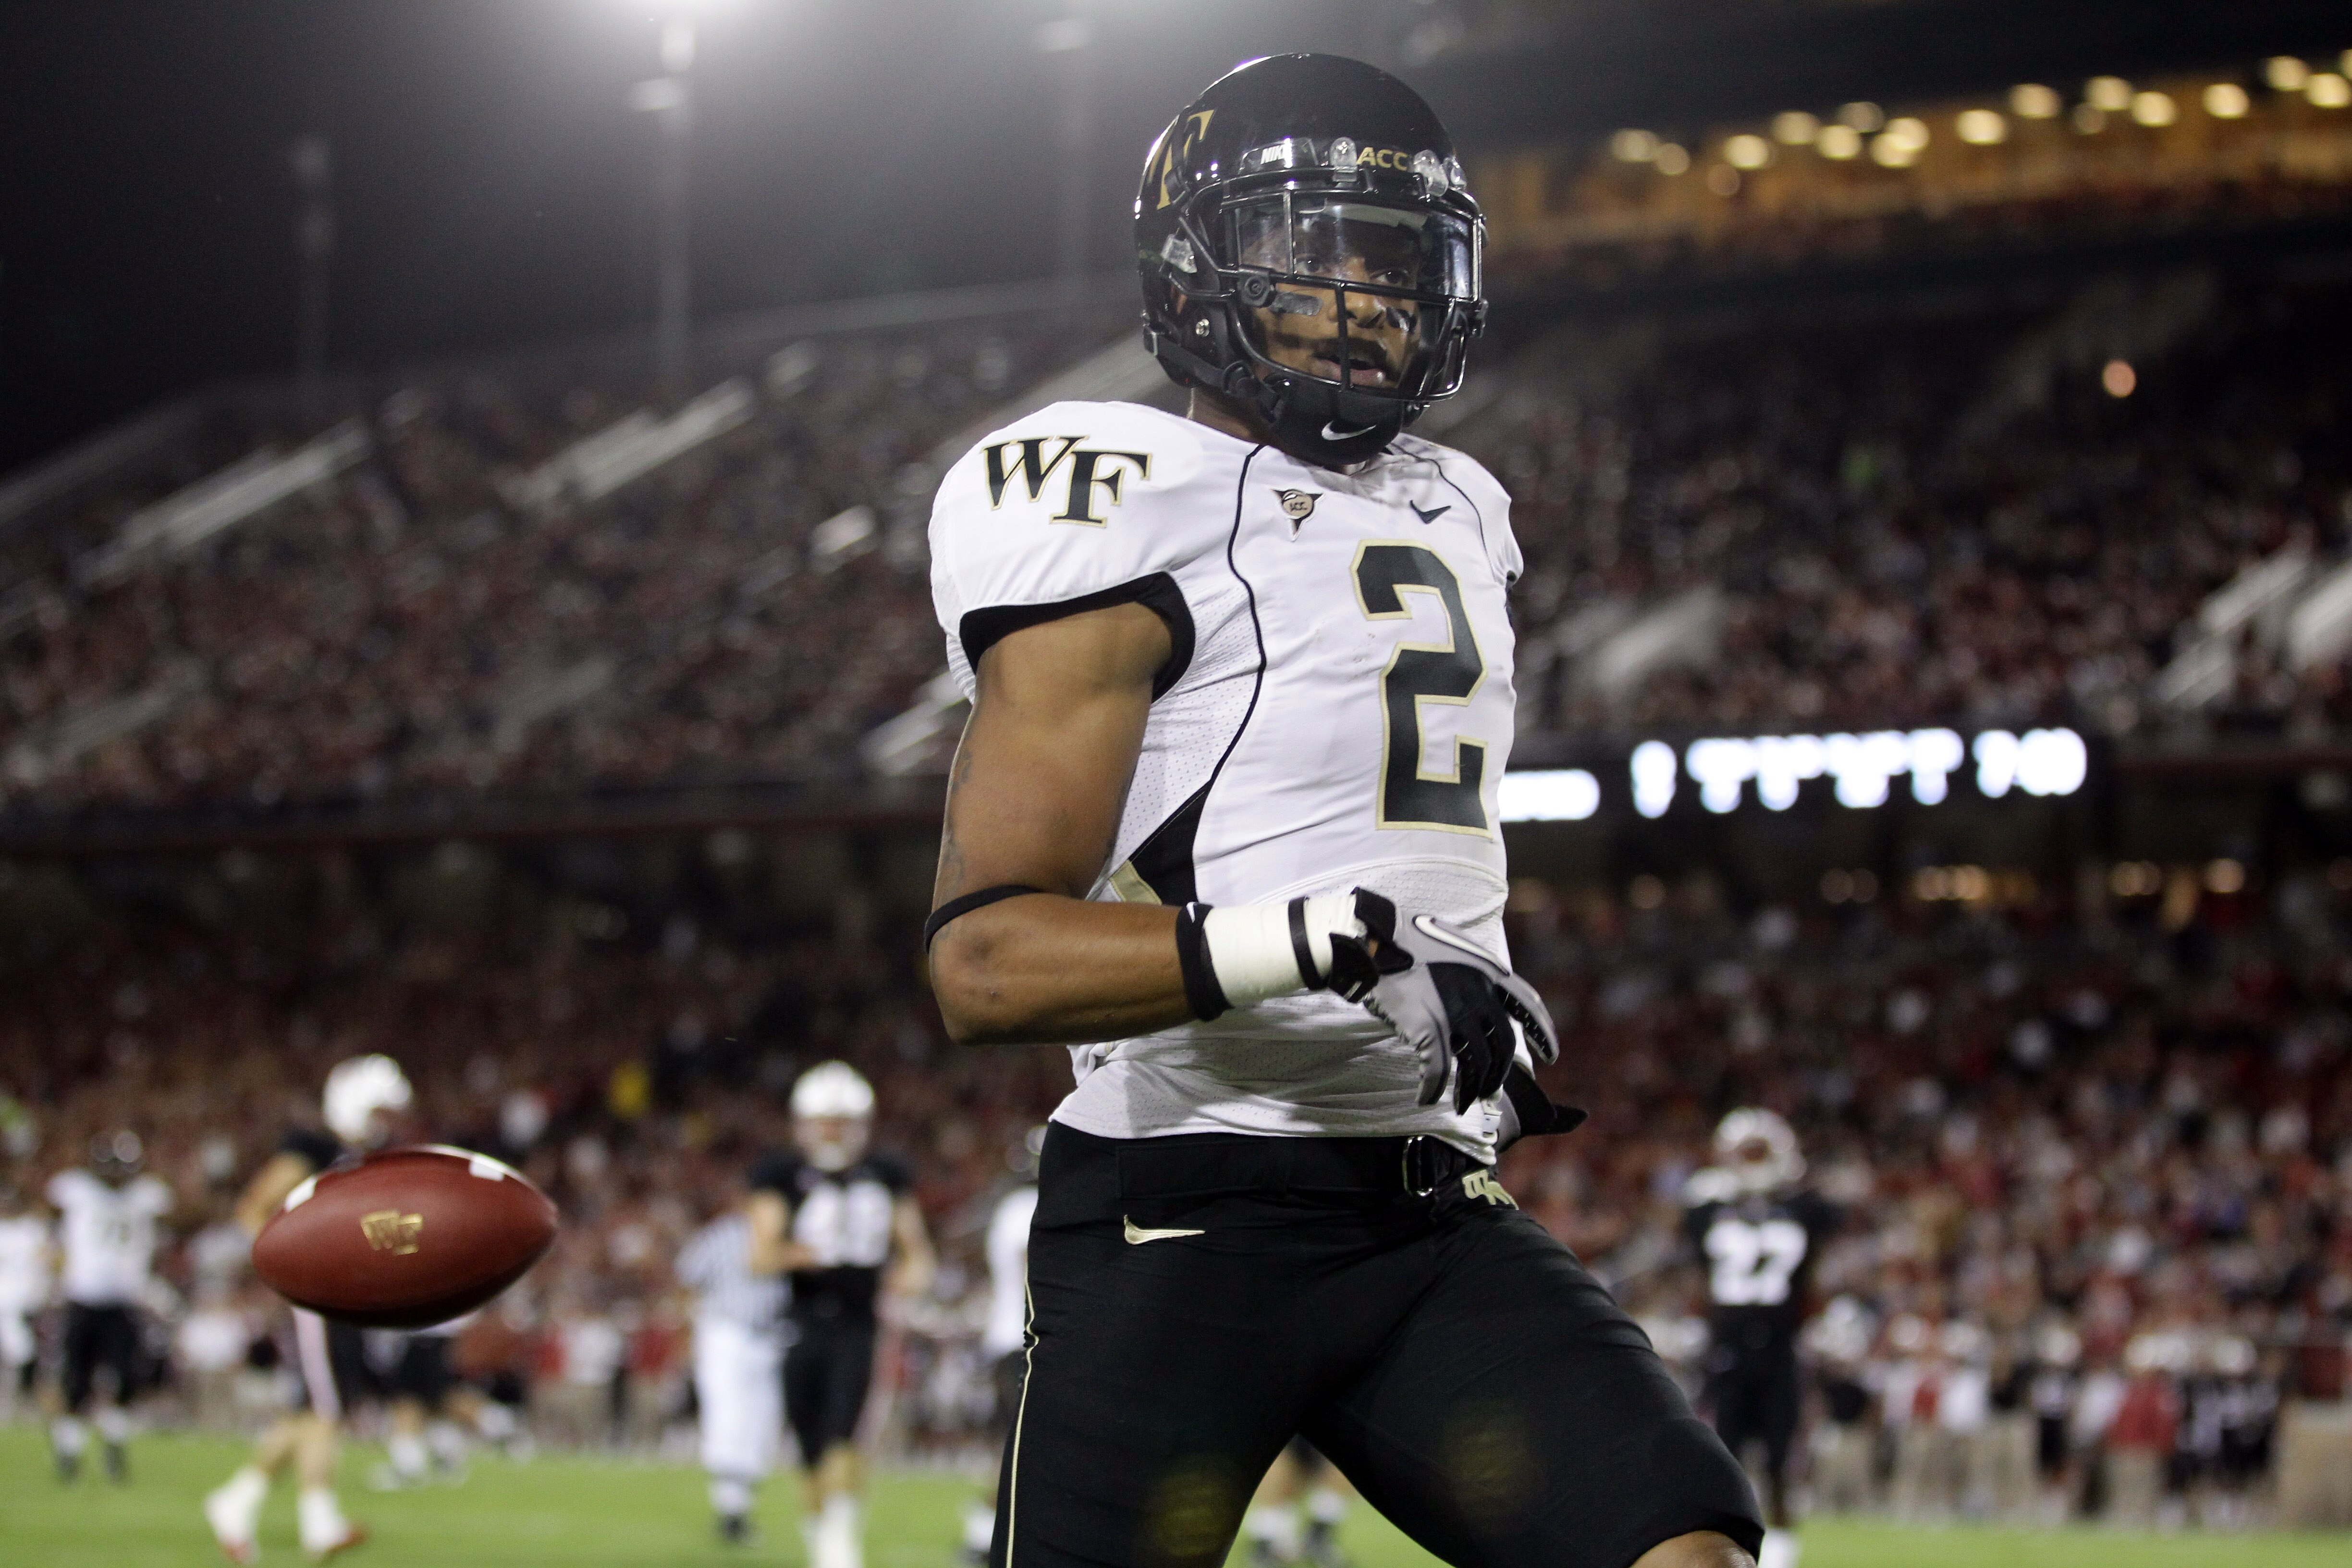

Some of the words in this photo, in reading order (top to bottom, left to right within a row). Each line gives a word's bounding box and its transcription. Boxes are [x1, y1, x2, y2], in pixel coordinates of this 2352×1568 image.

[1261, 144, 1292, 164] NIK
[1356, 147, 1408, 171] ACC
[980, 435, 1152, 528] WF
[1349, 539, 1492, 838] 2
